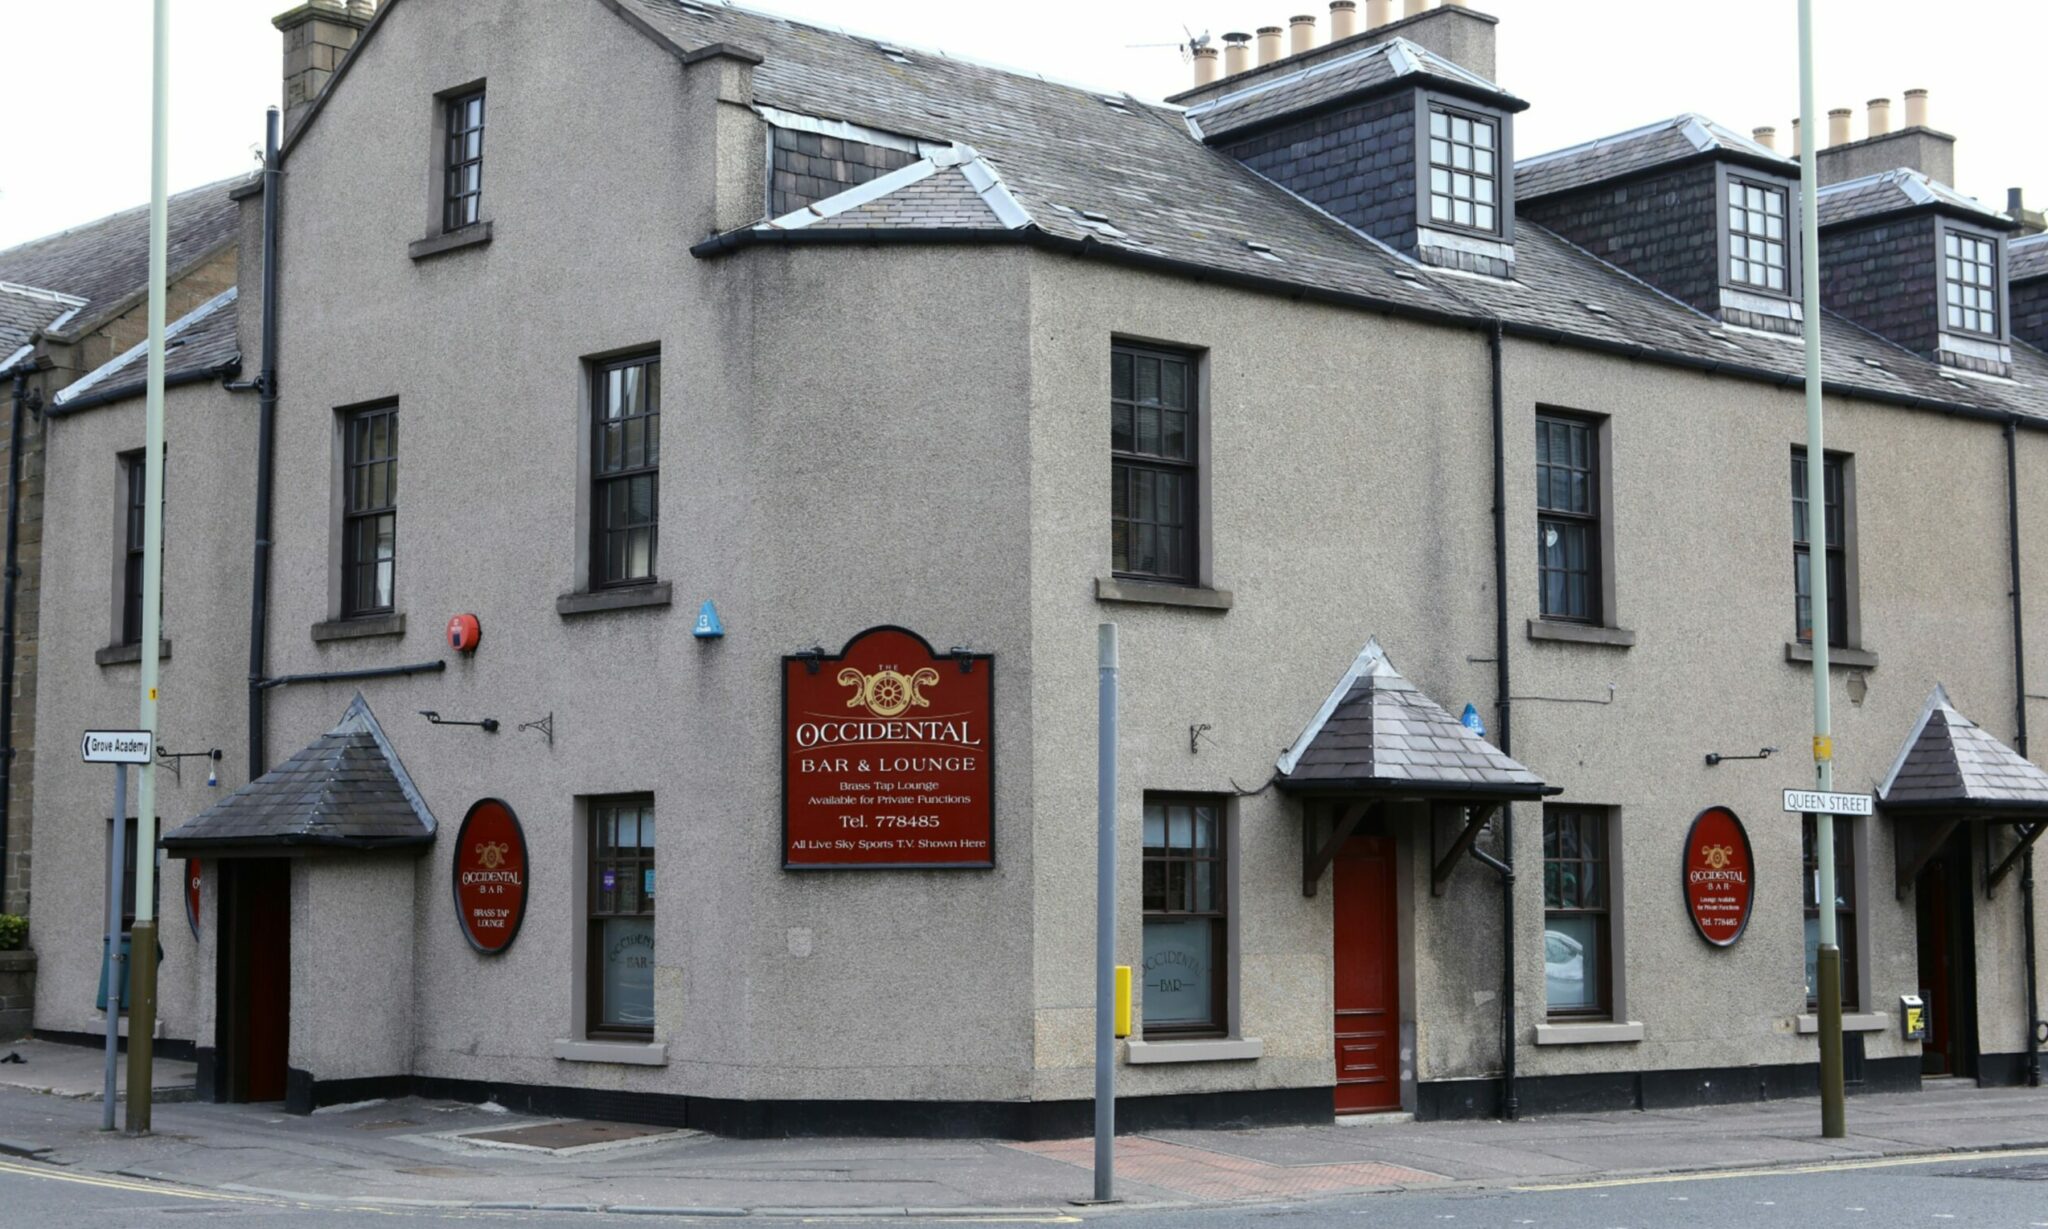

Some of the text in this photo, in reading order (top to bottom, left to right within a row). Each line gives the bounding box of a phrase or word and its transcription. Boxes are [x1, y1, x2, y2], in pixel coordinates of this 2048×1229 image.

[878, 664, 899, 672] THE
[796, 721, 981, 747] OCCIDENTAL
[91, 738, 149, 755] Grove Academy
[801, 757, 976, 773] BAR & LOUNGE
[1816, 765, 1822, 779] 1
[839, 781, 939, 792] Brass Tap Lounge
[808, 794, 971, 805] Available for Private Functions
[1787, 793, 1868, 812] QUEEN STREET
[839, 815, 940, 828] Tel. 778485
[792, 840, 806, 849] All
[808, 840, 833, 849] Live
[834, 839, 855, 851] Sky
[858, 839, 894, 850] Sports
[918, 838, 958, 848] Shown
[960, 838, 986, 848] Here
[462, 871, 522, 885] OCCIDENTAL
[1690, 870, 1746, 884] OCCIDENTAL
[480, 885, 503, 894] BAR
[1708, 883, 1730, 891] BAR
[474, 908, 510, 918] BRASS TAP
[477, 919, 505, 928] LOUNGE
[626, 956, 647, 969] BAR
[1160, 979, 1183, 992] BAR
